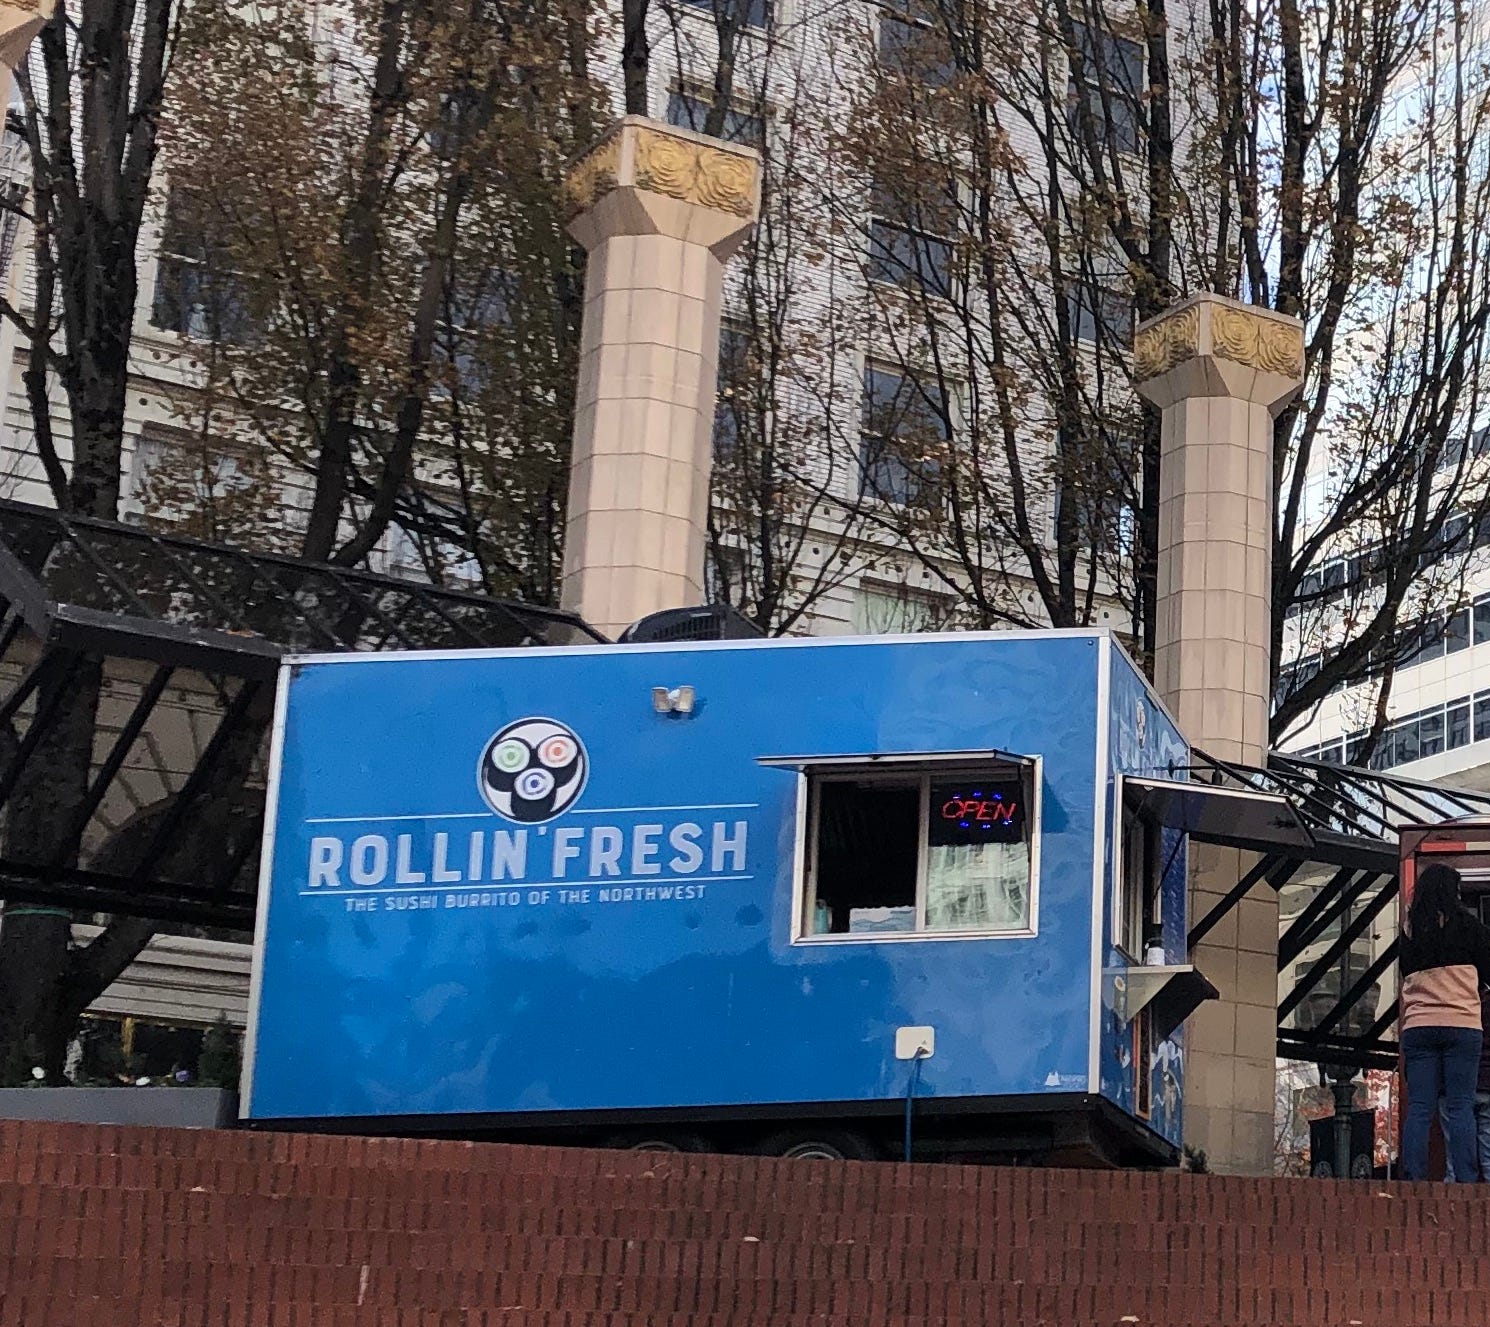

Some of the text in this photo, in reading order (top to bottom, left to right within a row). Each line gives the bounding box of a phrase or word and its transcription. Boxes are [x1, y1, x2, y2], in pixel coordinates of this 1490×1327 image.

[942, 800, 1017, 820] OPEN
[552, 821, 748, 878] FRESH
[345, 885, 706, 912] THE SUSHI BURRITO OF THE NORTHWEST
